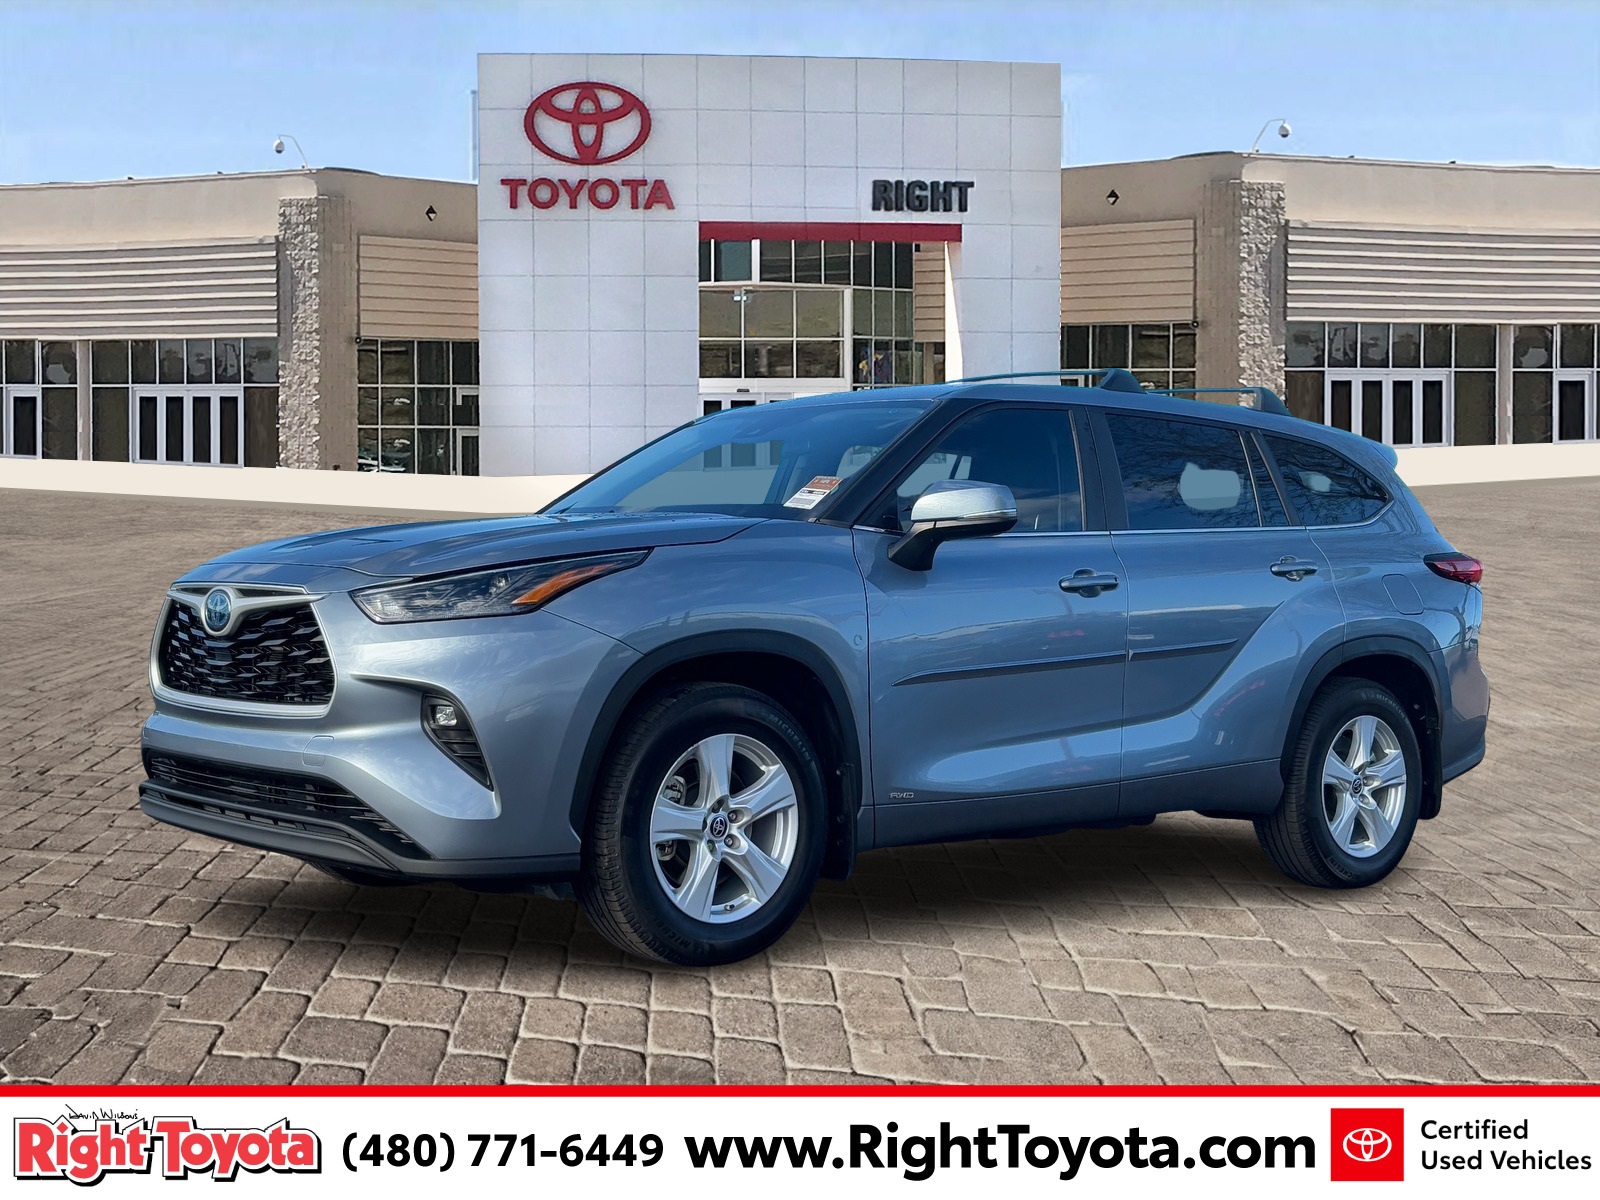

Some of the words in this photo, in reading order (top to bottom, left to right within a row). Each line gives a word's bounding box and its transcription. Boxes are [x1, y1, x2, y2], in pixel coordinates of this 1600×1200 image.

[501, 178, 674, 210] TOYOTA
[871, 179, 975, 212] RIGHT
[768, 713, 811, 760] MICHELIN
